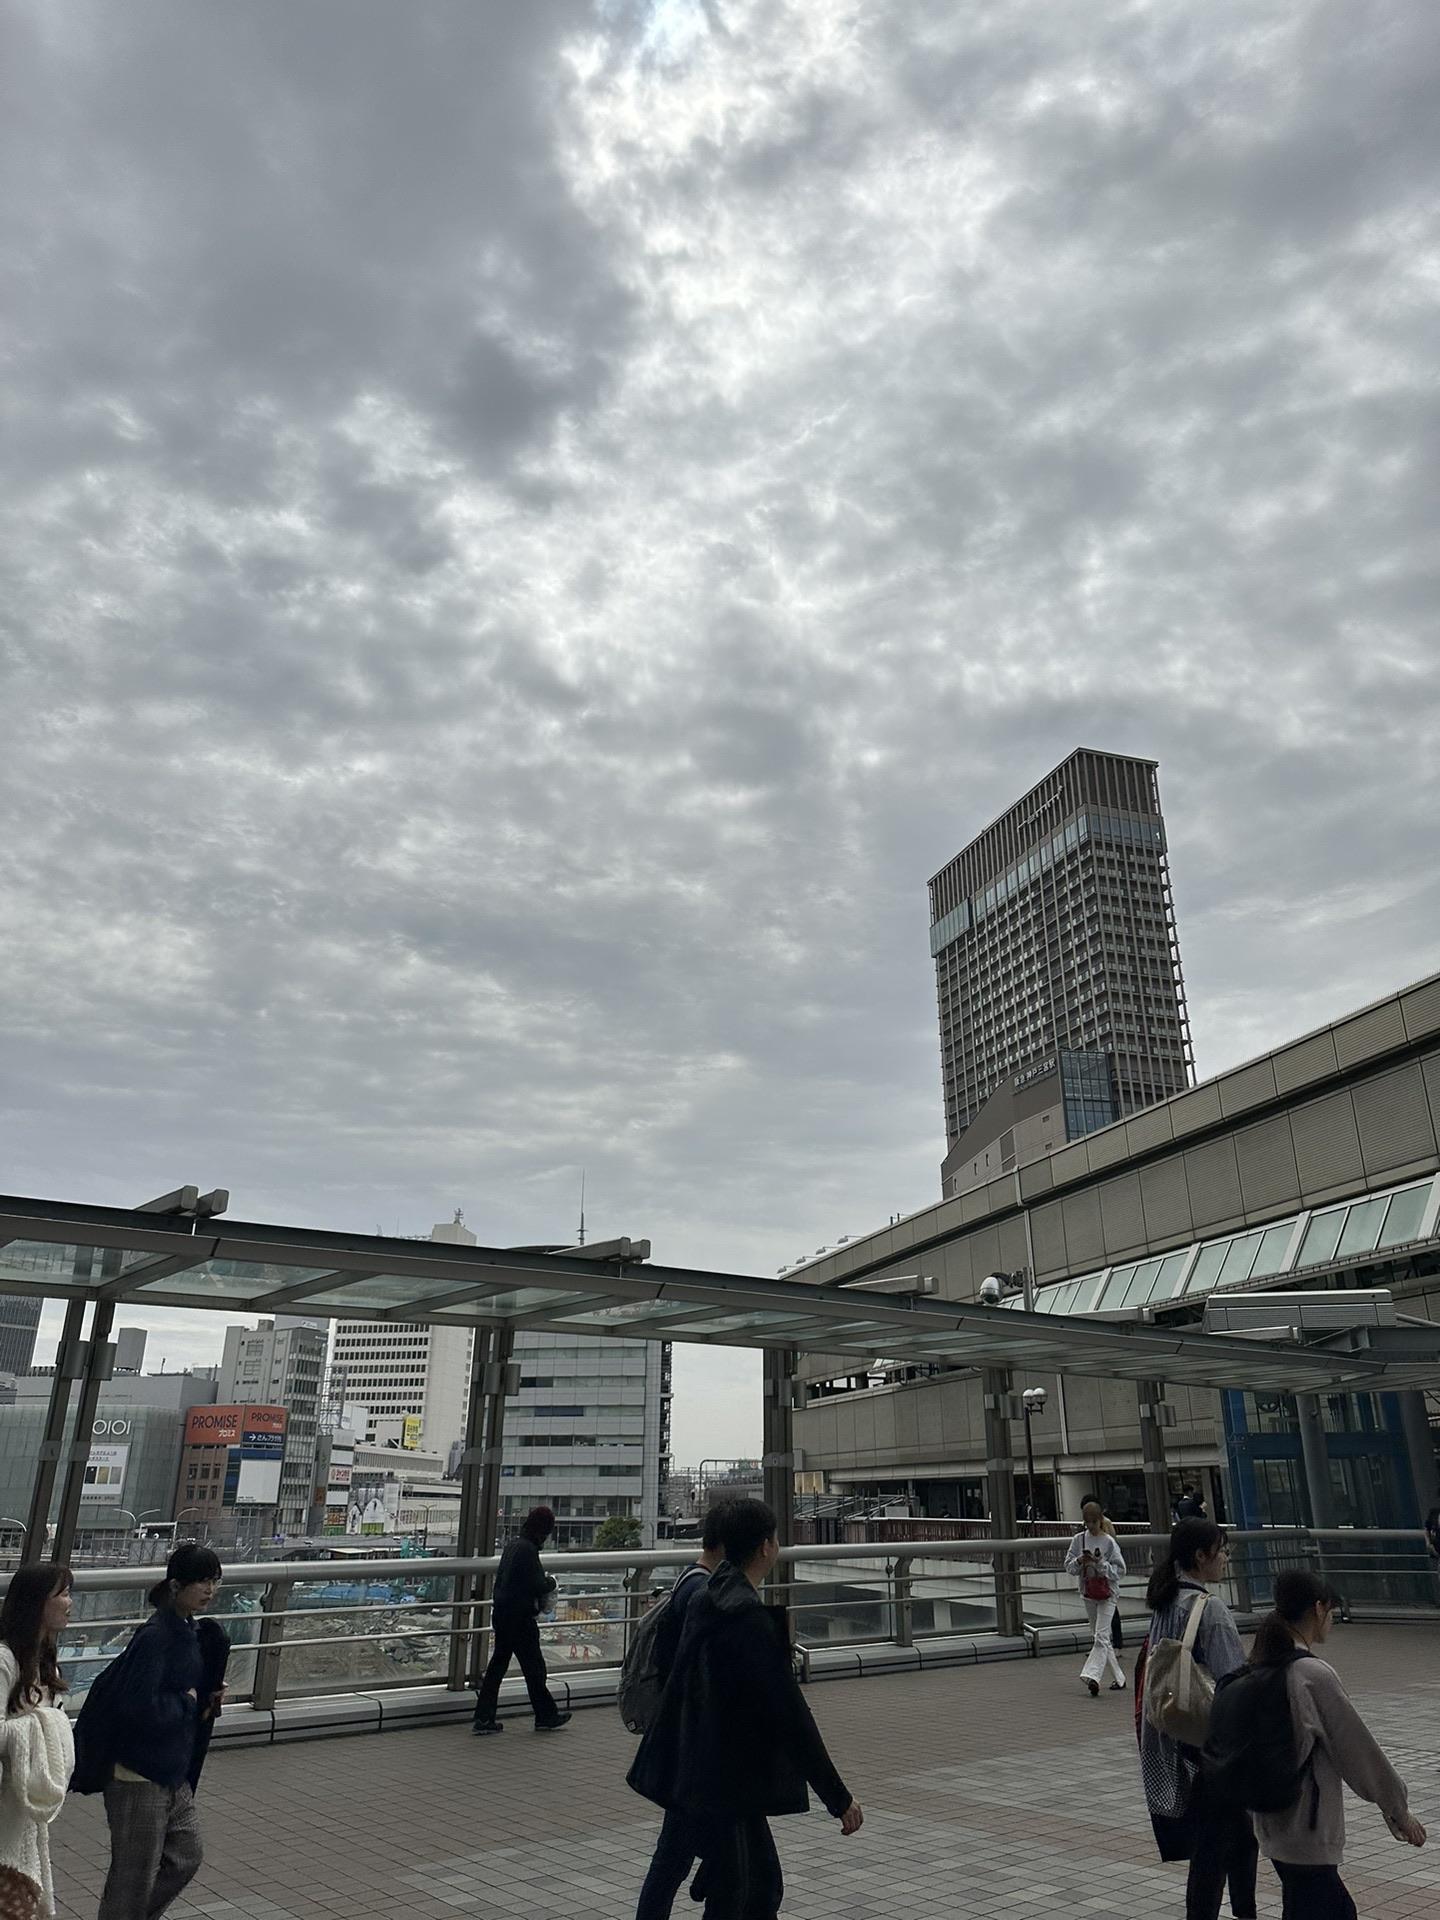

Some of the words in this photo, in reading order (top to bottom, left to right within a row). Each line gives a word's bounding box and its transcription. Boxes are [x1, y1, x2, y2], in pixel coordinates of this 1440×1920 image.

[192, 1414, 238, 1429] PROMISE
[218, 1429, 236, 1438] プロミス
